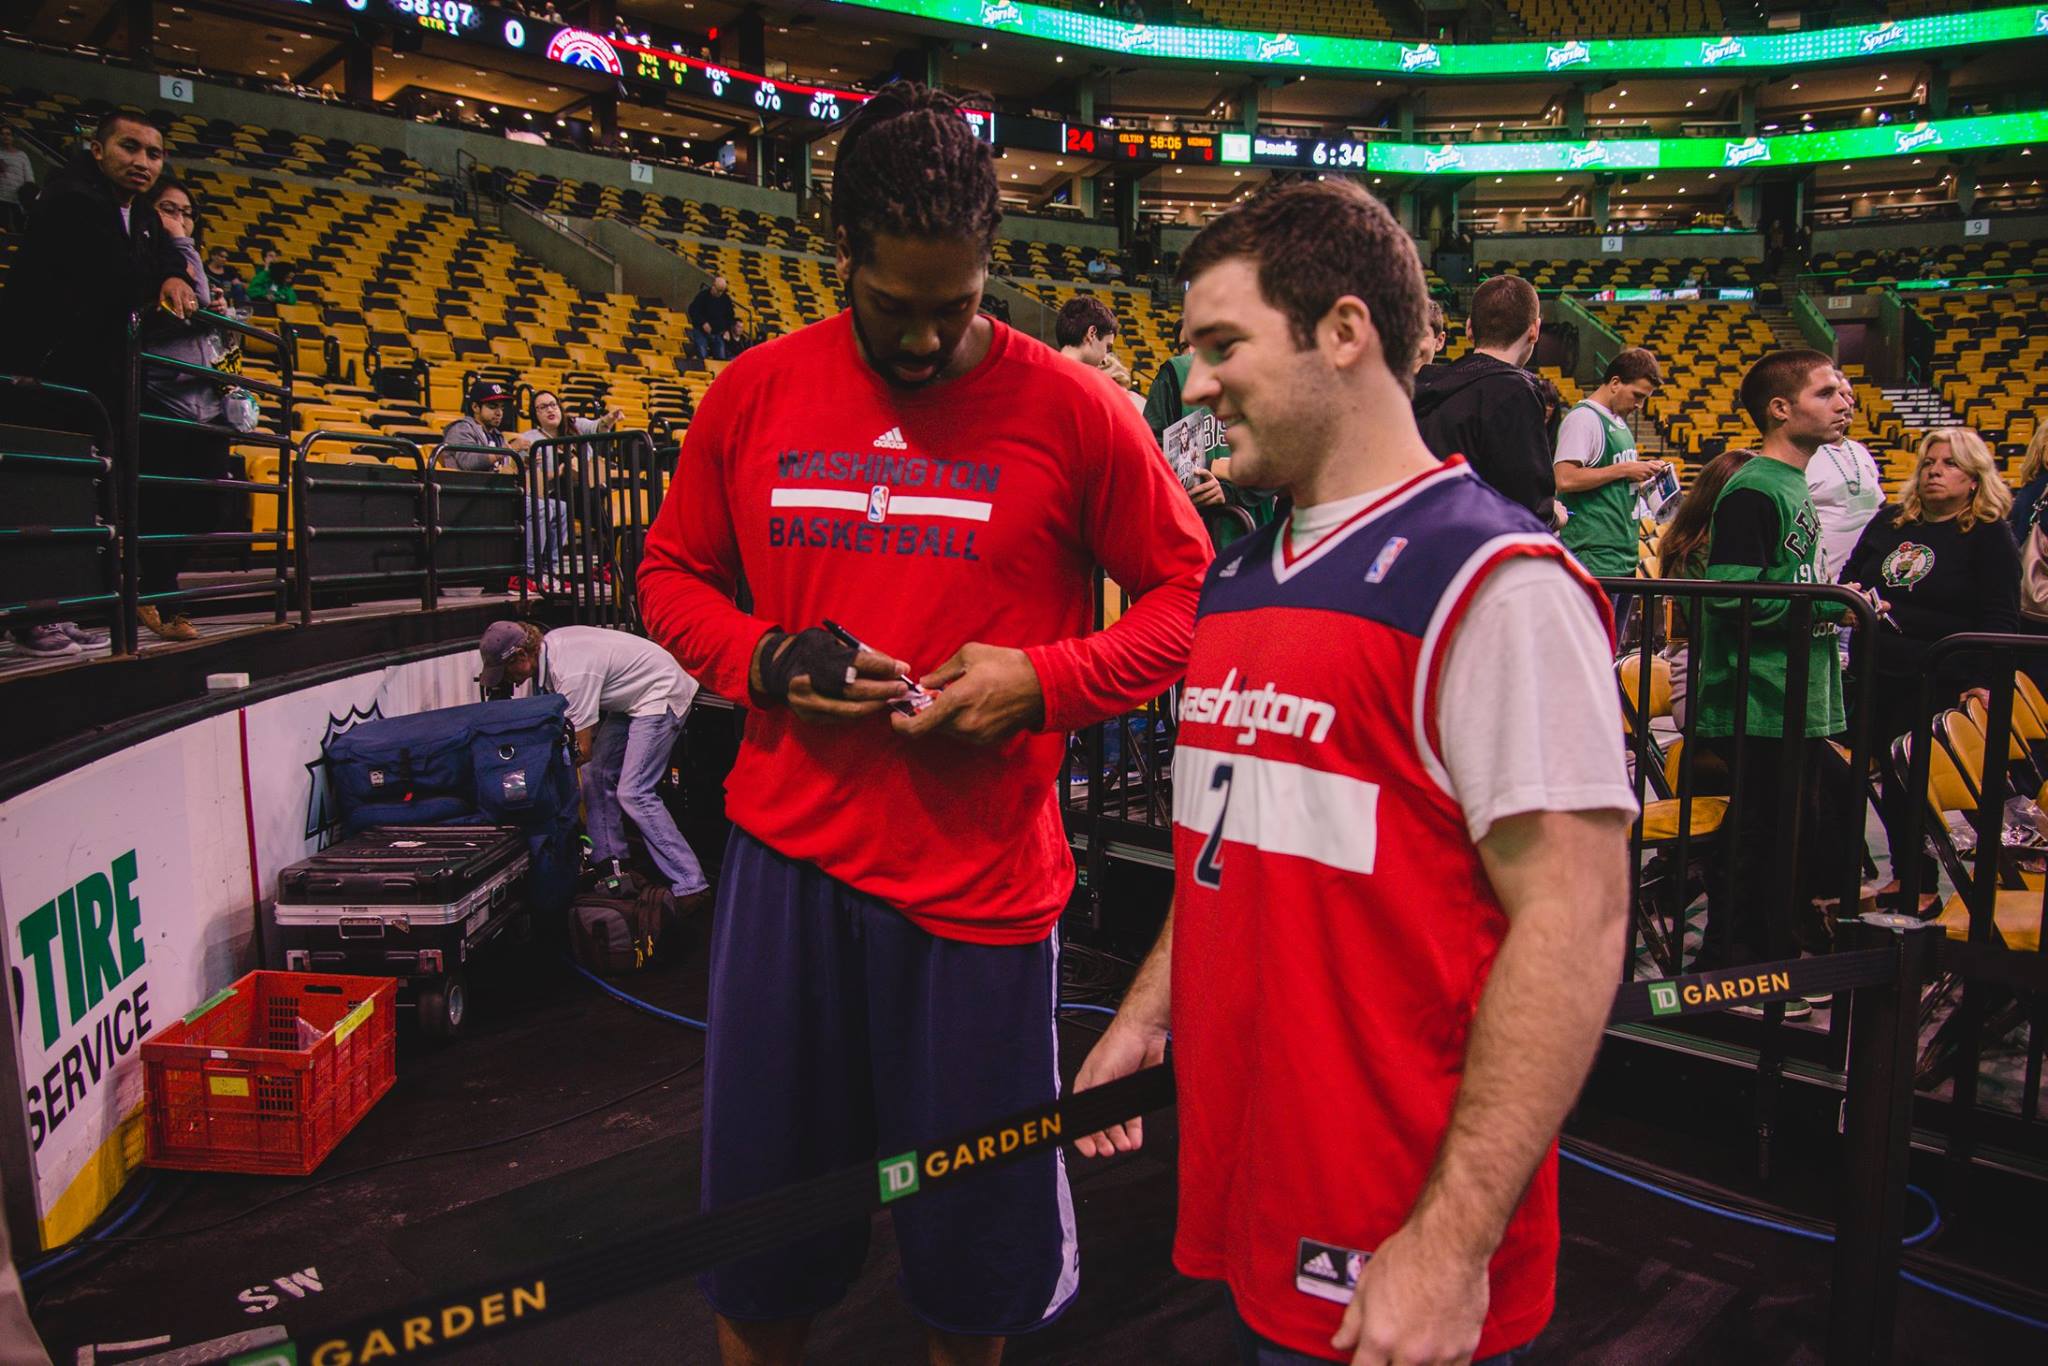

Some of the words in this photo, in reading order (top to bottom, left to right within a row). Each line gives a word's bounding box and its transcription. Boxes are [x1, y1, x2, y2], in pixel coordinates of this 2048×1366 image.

[418, 16, 446, 31] QTR
[449, 22, 459, 36] 1
[504, 20, 524, 48] 0
[1861, 24, 1905, 53] Sprite
[1261, 39, 1297, 60] Sprite
[1404, 49, 1439, 70] Sprite
[1548, 47, 1586, 69] Sprite
[1701, 41, 1743, 65] Sprite
[674, 72, 683, 85] 0
[706, 66, 731, 84] FG%
[172, 80, 183, 98] 6
[712, 80, 723, 97] 0
[761, 81, 776, 95] FG
[814, 91, 836, 105] 3PT
[754, 91, 781, 111] 0/0
[809, 103, 840, 121] 0/0
[966, 112, 984, 125] REB
[1067, 127, 1095, 153] 24
[1150, 135, 1182, 150] 58:06
[1897, 128, 1938, 153] Sprite
[1312, 142, 1366, 168] 6:34
[1728, 142, 1767, 167] Sprite
[637, 165, 645, 179] 7
[1973, 220, 1983, 234] 9
[1608, 238, 1616, 250] 9
[777, 449, 1002, 494] WASHINGTON
[769, 516, 980, 562] BASKETBALL
[1193, 760, 1235, 891] 2
[19, 848, 146, 1053] TIRE
[1651, 987, 1678, 1009] TD
[1683, 971, 1791, 1006] GARDEN
[27, 981, 153, 1153] SERVICE
[881, 1159, 916, 1193] TD
[925, 1112, 1063, 1179] GARDEN
[311, 1280, 547, 1366] GARDEN
